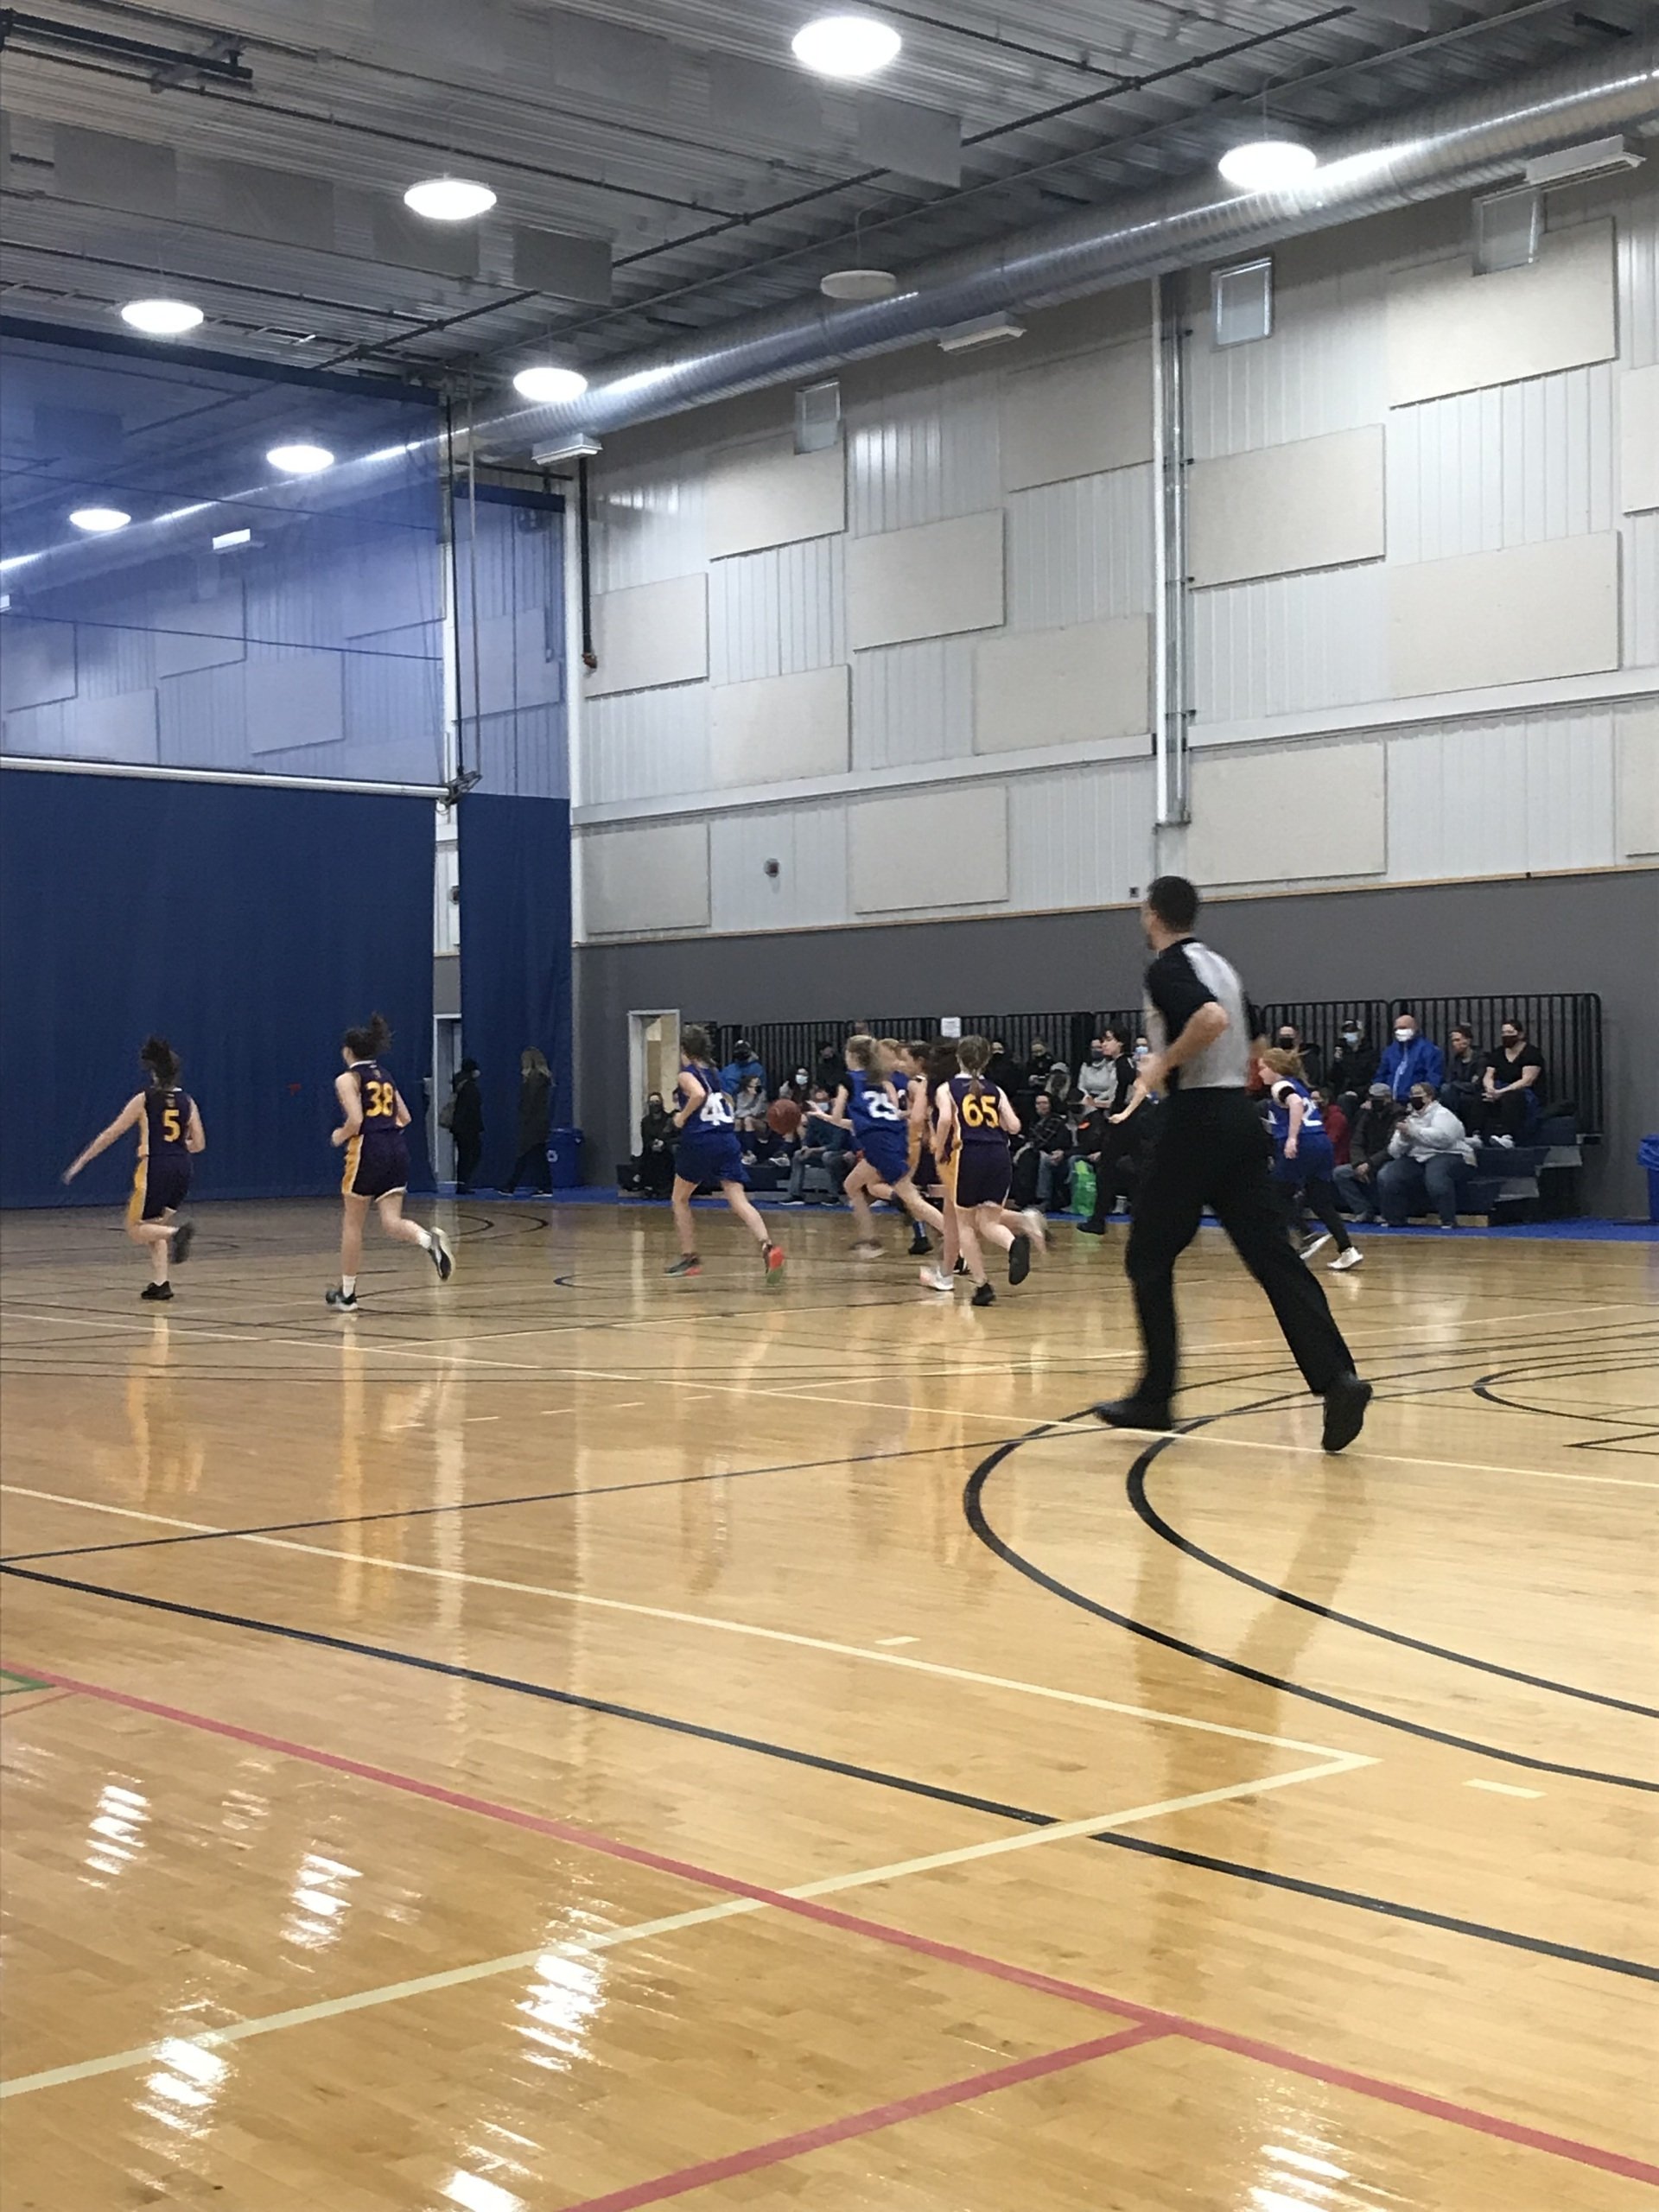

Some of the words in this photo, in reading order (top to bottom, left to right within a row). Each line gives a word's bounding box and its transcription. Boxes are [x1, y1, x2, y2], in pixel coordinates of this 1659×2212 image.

[366, 1081, 393, 1117] 38
[962, 1093, 999, 1128] 65
[163, 1109, 181, 1142] 5
